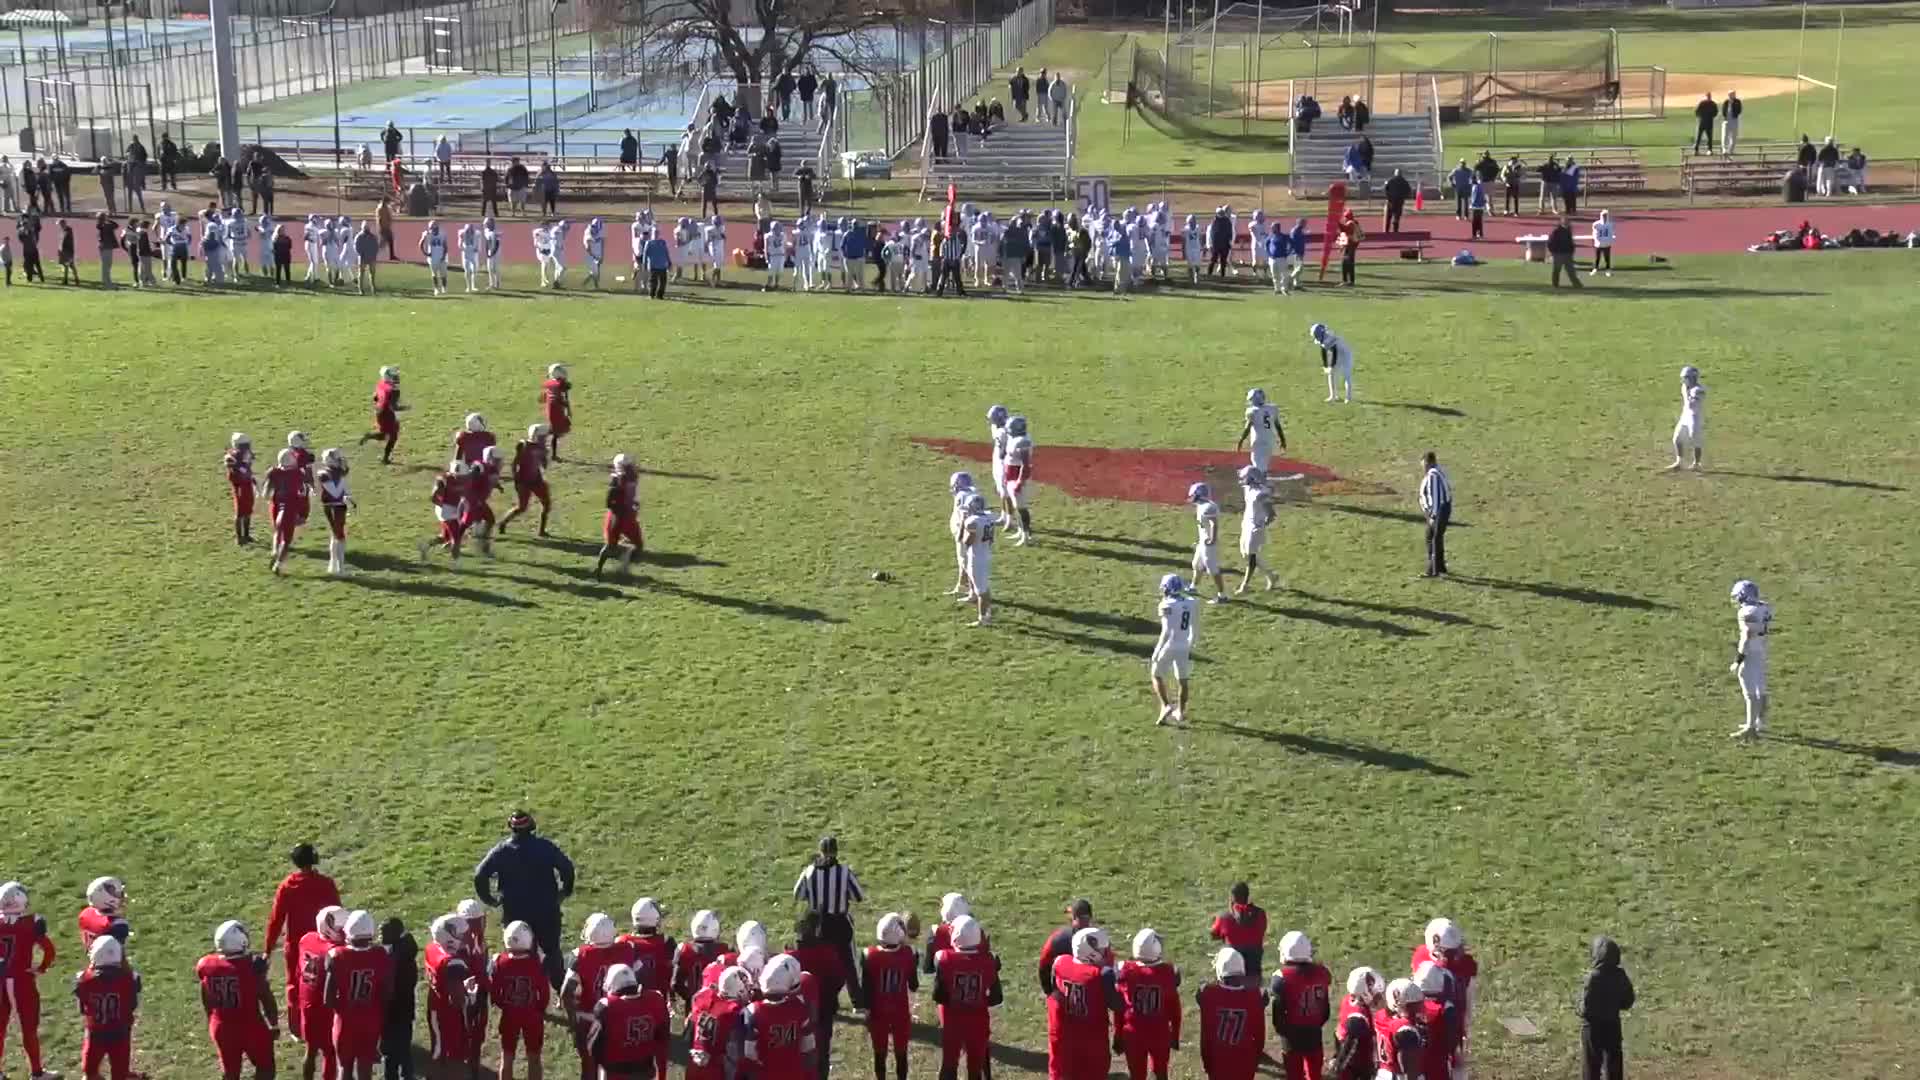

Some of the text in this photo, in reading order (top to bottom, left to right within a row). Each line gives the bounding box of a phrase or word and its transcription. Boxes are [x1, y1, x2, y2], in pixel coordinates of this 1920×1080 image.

[1077, 180, 1109, 216] 50
[1263, 415, 1271, 429] 5
[1181, 611, 1190, 631] 8
[1215, 1009, 1247, 1047] 77
